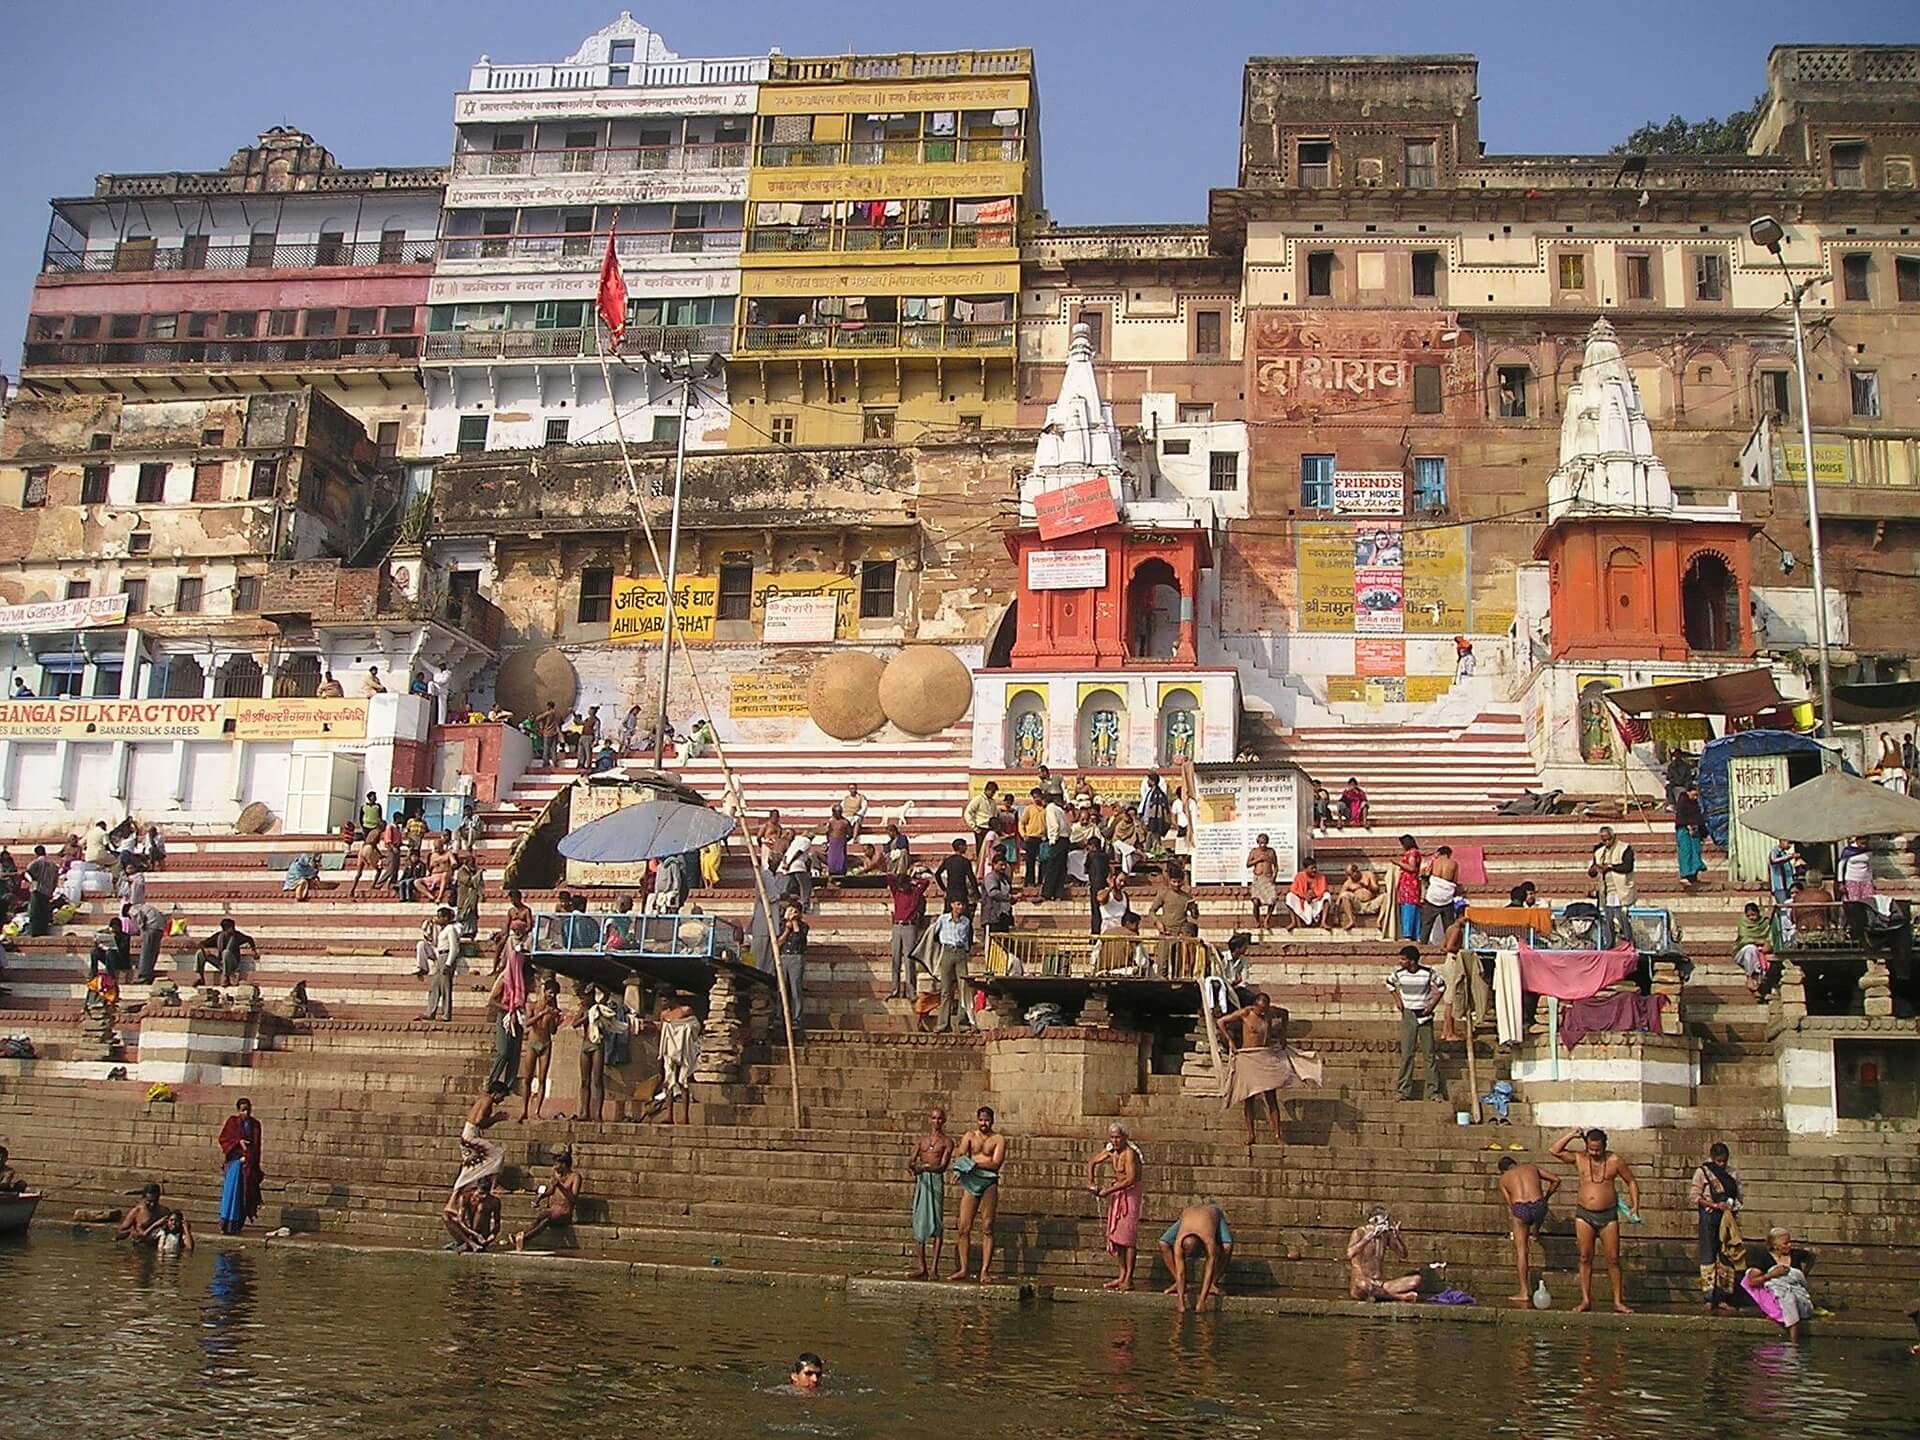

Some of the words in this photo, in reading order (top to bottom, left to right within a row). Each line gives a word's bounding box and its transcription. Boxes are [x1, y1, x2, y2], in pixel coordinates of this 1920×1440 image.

[1335, 489, 1366, 498] GUEST
[1370, 489, 1400, 498] HOUSE
[693, 590, 715, 607] घाट
[612, 616, 666, 633] AHILYAB
[676, 615, 712, 632] GHAT
[0, 703, 56, 723] GANGA
[60, 704, 115, 723] SILK
[118, 703, 221, 723] FACTORY
[11, 726, 24, 736] ALL
[26, 725, 51, 736] KINDS
[52, 725, 63, 735] OF
[100, 725, 138, 735] BANARASI
[139, 725, 161, 736] SILK
[164, 725, 200, 736] SAREES
